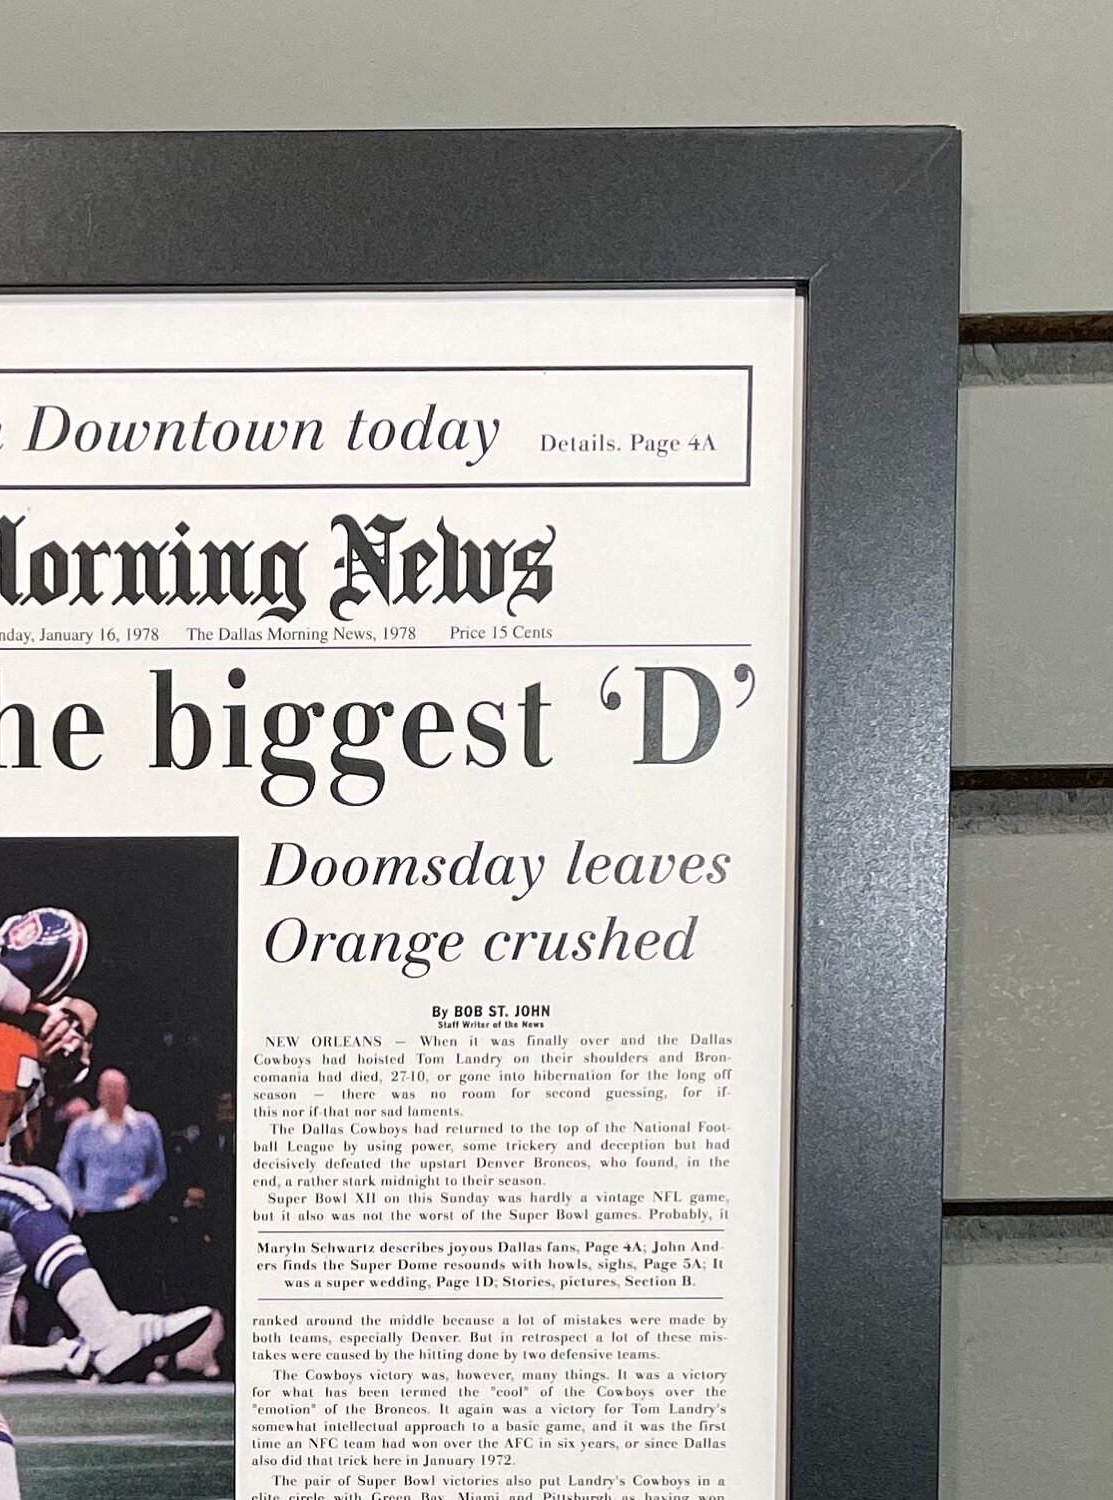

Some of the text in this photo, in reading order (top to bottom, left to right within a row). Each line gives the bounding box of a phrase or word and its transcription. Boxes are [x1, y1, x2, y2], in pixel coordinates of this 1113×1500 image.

[22, 406, 324, 452] Downtown
[348, 404, 500, 467] today
[540, 433, 717, 458] Details. Page 4A
[330, 514, 556, 621] News
[39, 627, 94, 645] January
[100, 627, 120, 643] 16,
[127, 627, 159, 641] 1978
[186, 627, 214, 641] The
[218, 627, 263, 641] Dallas
[267, 627, 329, 645] Morning
[333, 626, 377, 642] News,
[383, 626, 417, 641] 1978
[450, 625, 486, 640] Price
[493, 625, 508, 639] 15
[512, 625, 553, 639] Cents
[149, 668, 553, 807] biggest
[600, 664, 755, 764] ‘D’
[260, 840, 730, 901] Doomsday leaves
[266, 916, 698, 978] Orange crushed
[431, 1004, 551, 1021] By BOB ST. JOHN
[437, 1019, 545, 1029] Staff Writer of the News
[257, 1241, 306, 1258] Maryln
[310, 1241, 375, 1254] Schwartz
[379, 1241, 445, 1254] describes
[446, 1241, 493, 1257] joyous
[497, 1241, 543, 1253] Dallas
[585, 1241, 619, 1257] Page
[651, 1240, 686, 1255] John
[690, 1240, 726, 1252] And-
